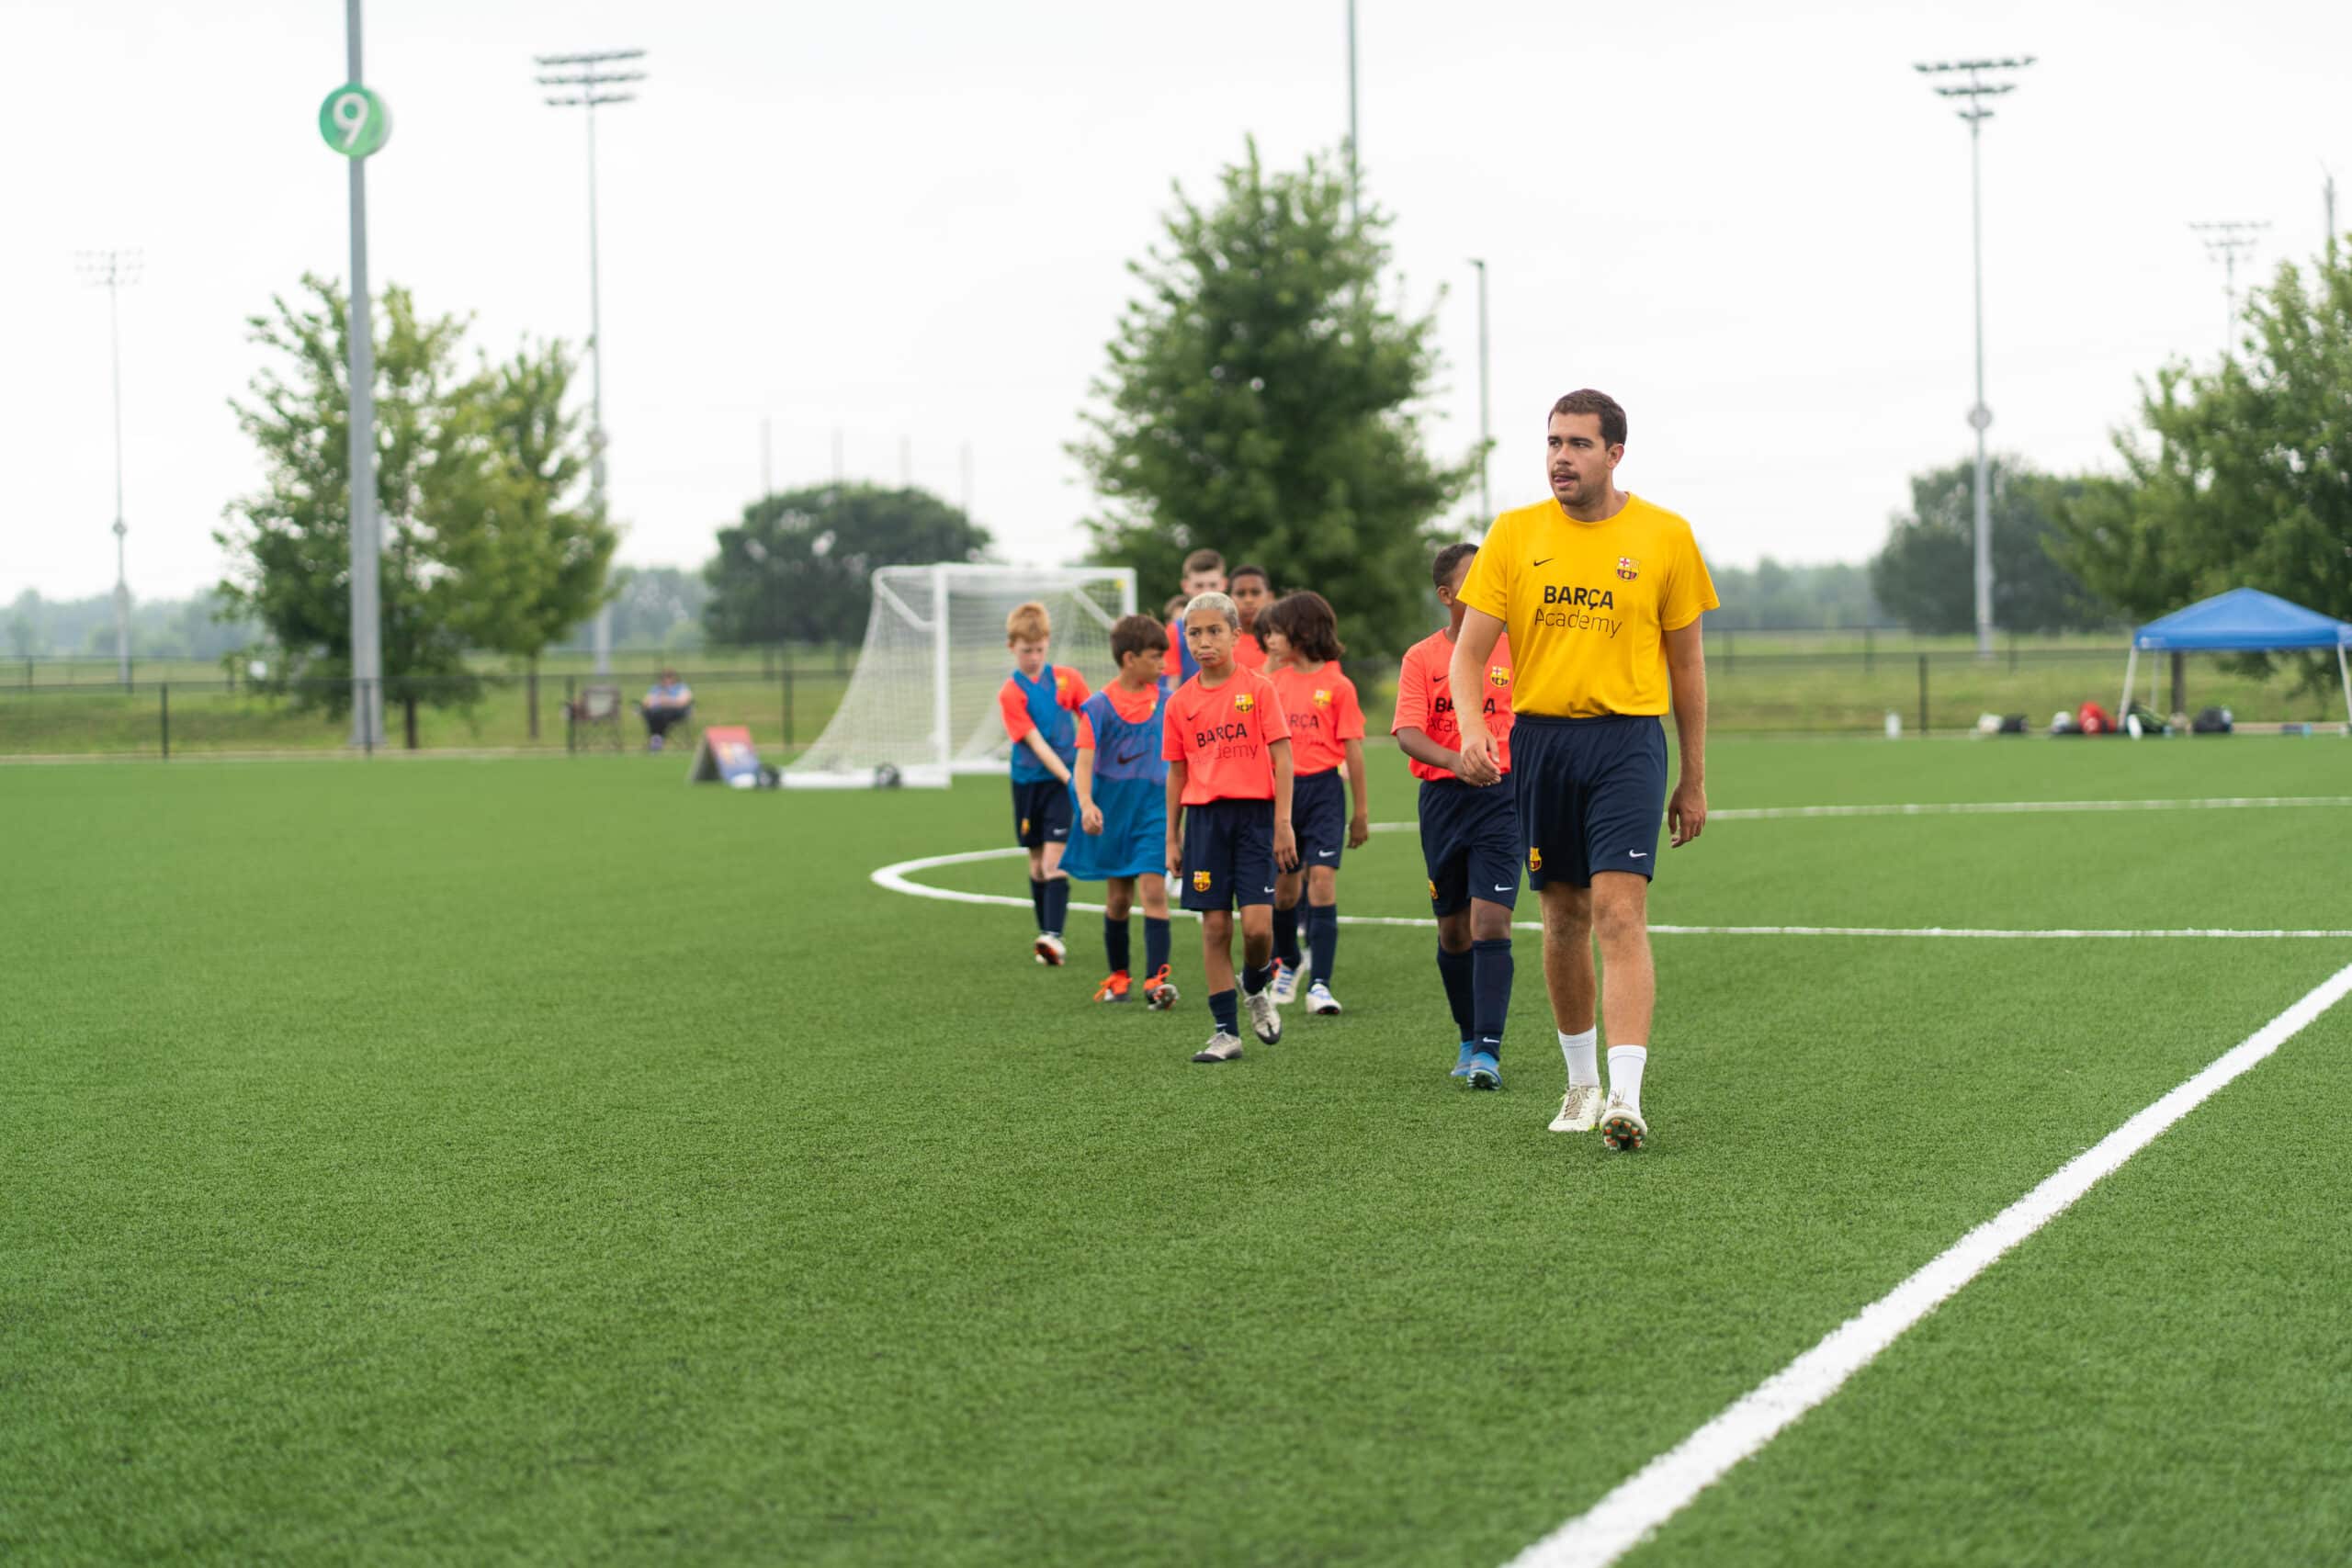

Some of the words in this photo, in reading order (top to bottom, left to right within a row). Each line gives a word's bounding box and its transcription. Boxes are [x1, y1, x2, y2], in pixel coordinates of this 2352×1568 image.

[334, 93, 368, 148] 9
[1544, 585, 1614, 610] BARÇA
[1534, 608, 1623, 638] Academy
[1435, 696, 1496, 715] BAA
[1196, 723, 1248, 748] BARÇA
